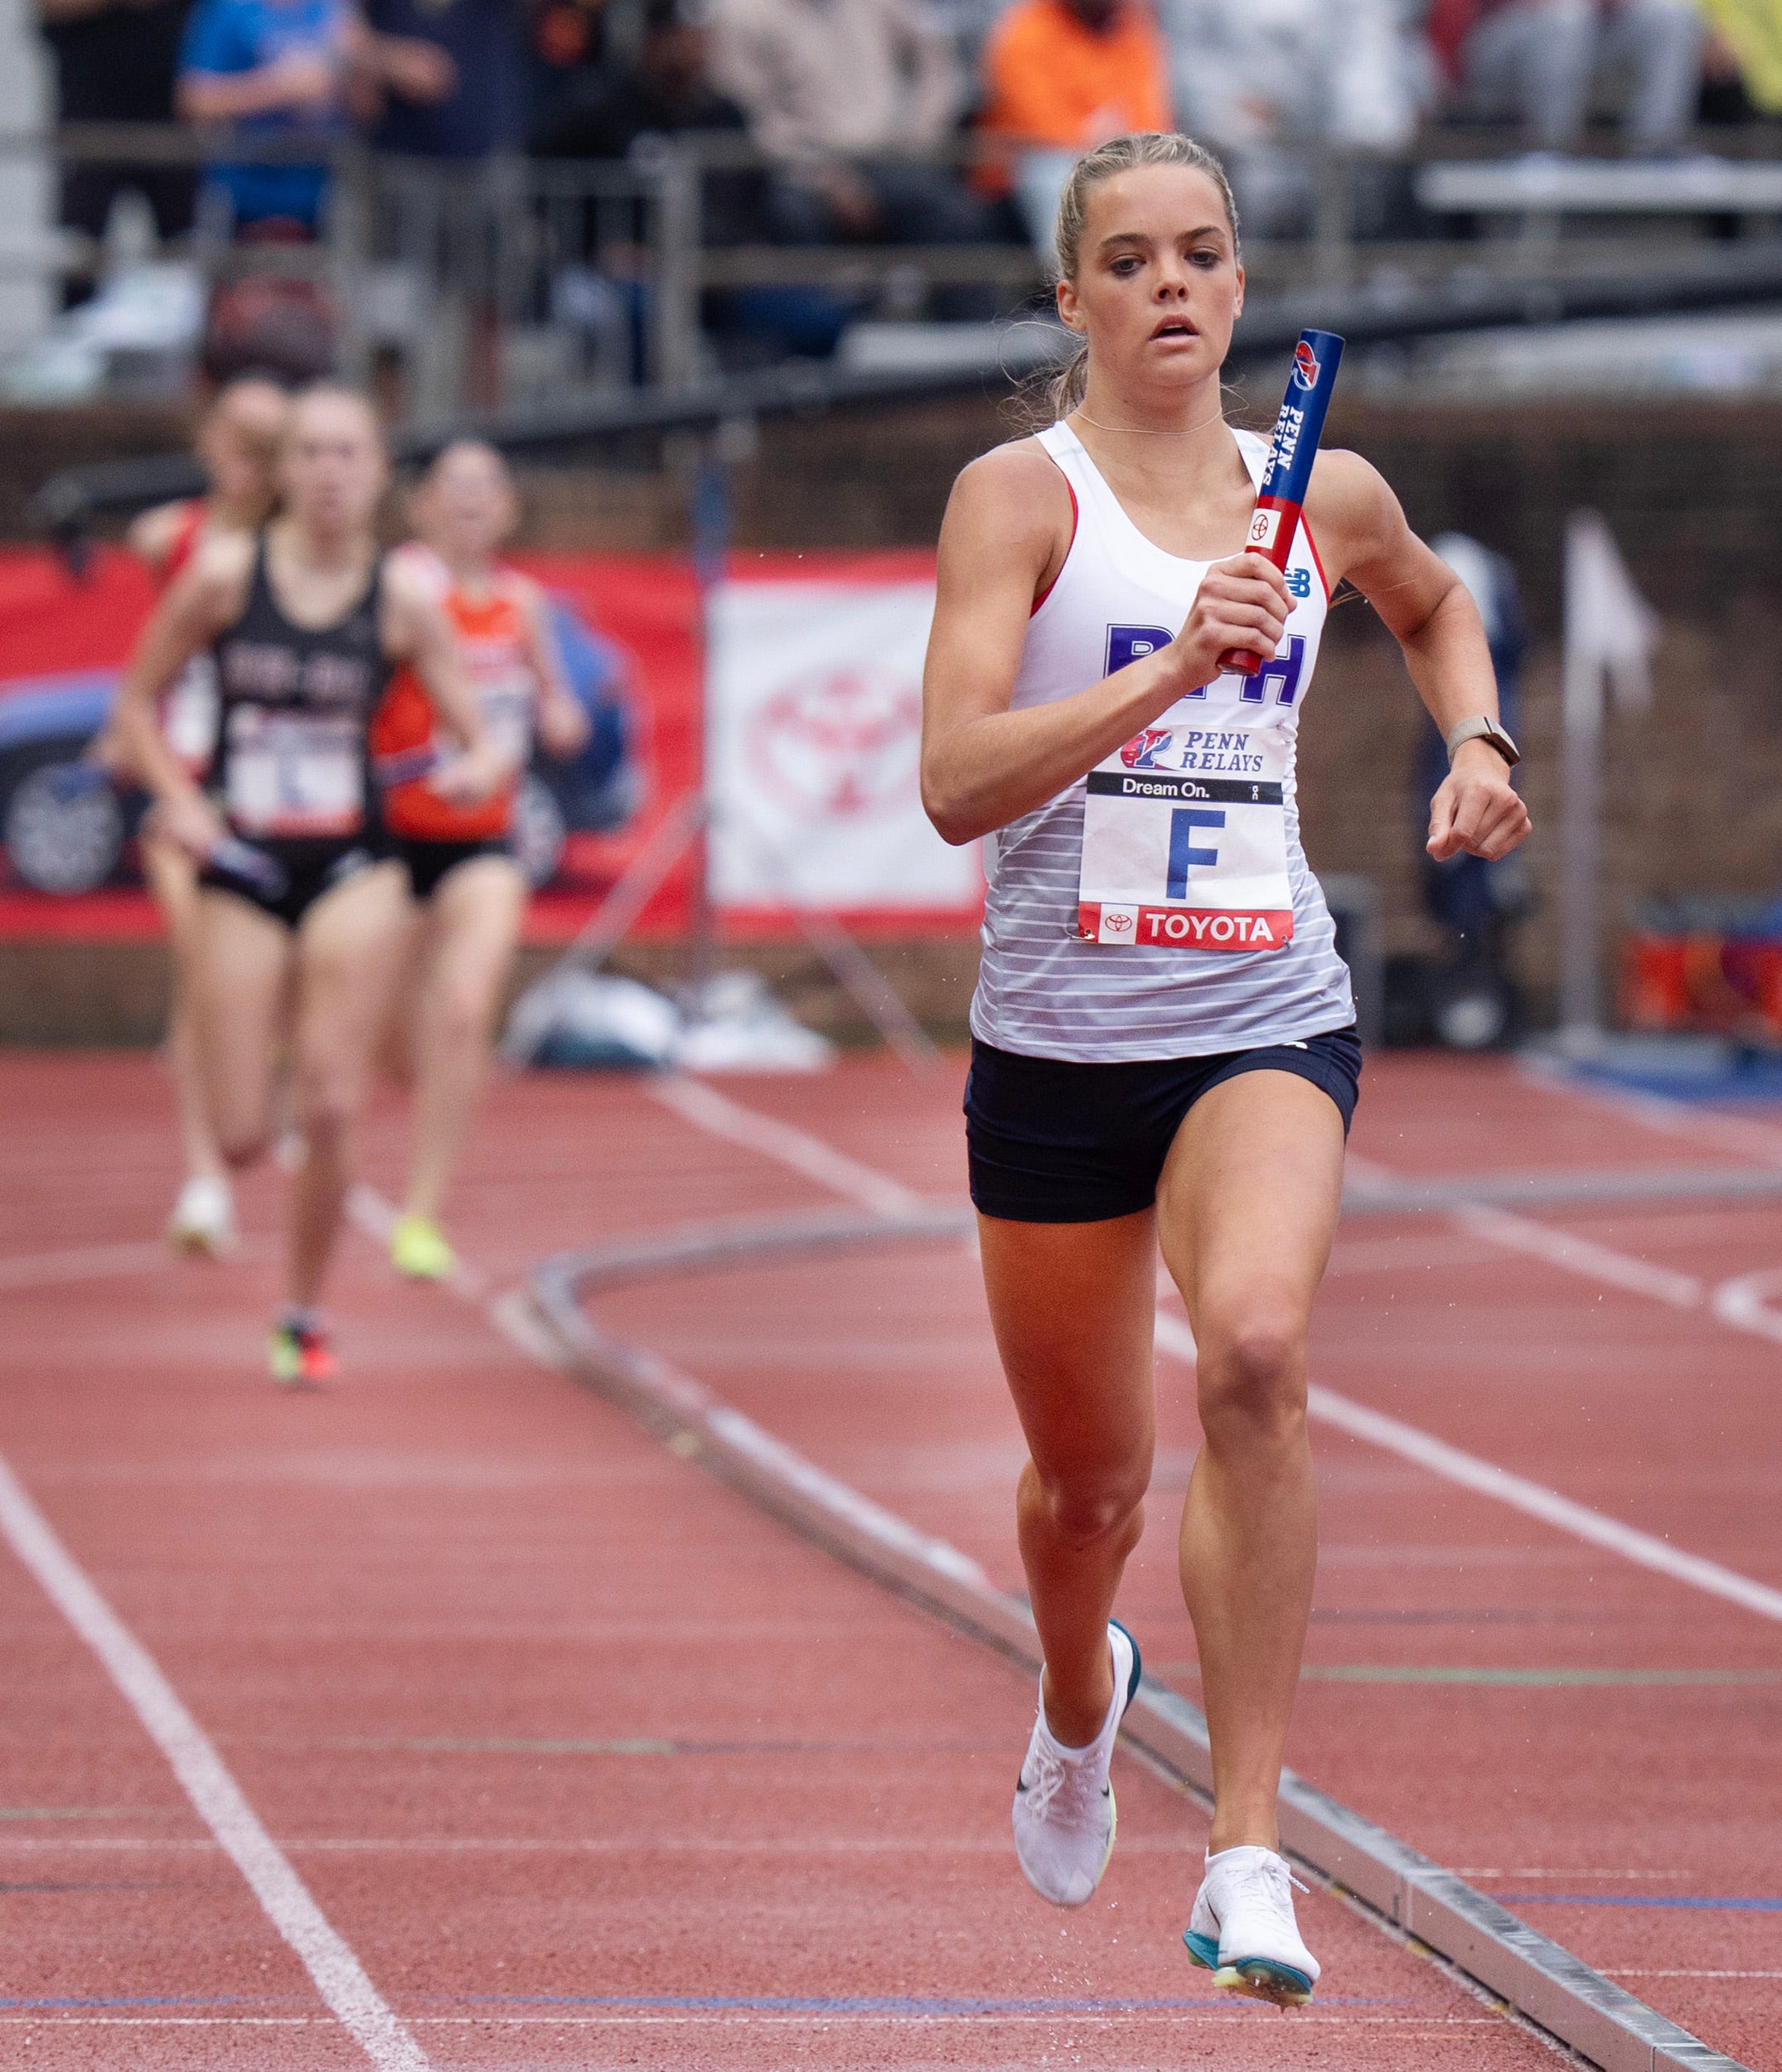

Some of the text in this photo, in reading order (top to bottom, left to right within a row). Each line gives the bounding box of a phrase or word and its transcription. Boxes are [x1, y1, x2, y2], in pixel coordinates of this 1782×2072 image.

[1262, 404, 1290, 487] RELAYS
[1276, 406, 1305, 471] PENN
[1184, 731, 1250, 751] PENN
[1179, 752, 1263, 772] RELAYS
[1122, 777, 1210, 798] Dream On.
[1165, 808, 1226, 900] F
[1145, 913, 1274, 942] TOYOTA
